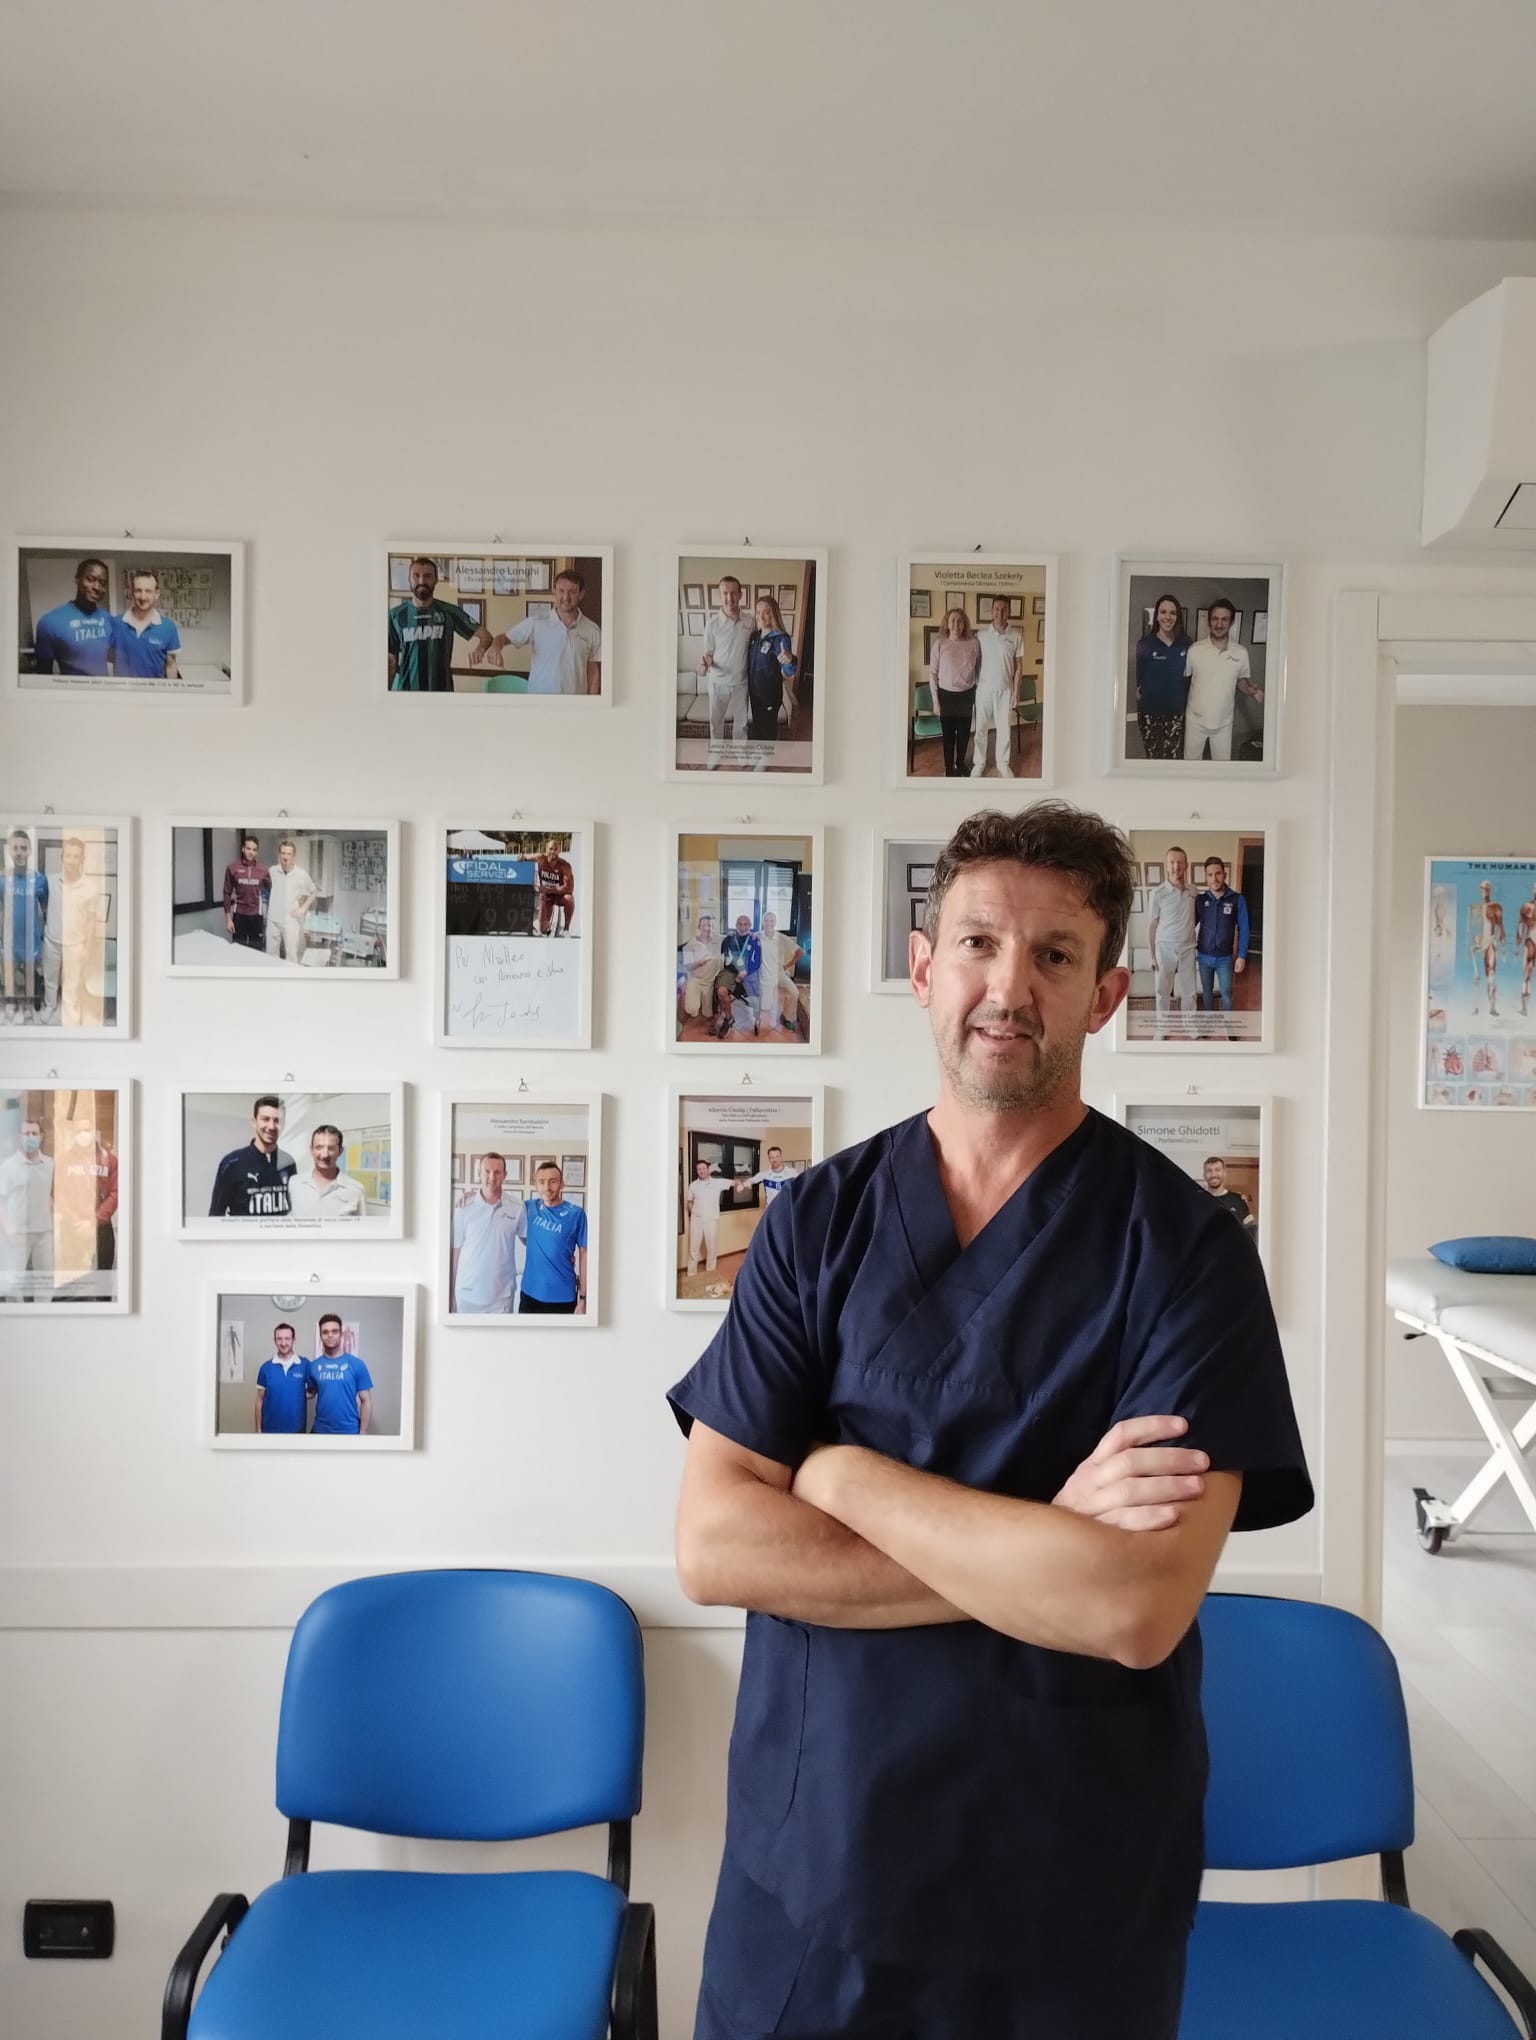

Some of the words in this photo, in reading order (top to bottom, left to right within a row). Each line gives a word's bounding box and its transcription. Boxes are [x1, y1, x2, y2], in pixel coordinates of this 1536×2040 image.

[455, 565, 506, 576] Alessandro
[507, 566, 540, 576] Longhi
[934, 571, 965, 580] Violetta
[994, 571, 1024, 582] Szekely
[75, 628, 106, 642] ITALIA
[402, 625, 444, 642] MAPEI
[465, 861, 506, 872] FIDAL
[466, 871, 507, 879] SERVIZI
[541, 869, 560, 881] POLIZIA
[1137, 1125, 1176, 1136] Simone
[1178, 1125, 1220, 1136] Ghidotti
[532, 1215, 563, 1235] ITALIA
[319, 1370, 345, 1381] ITALIA
